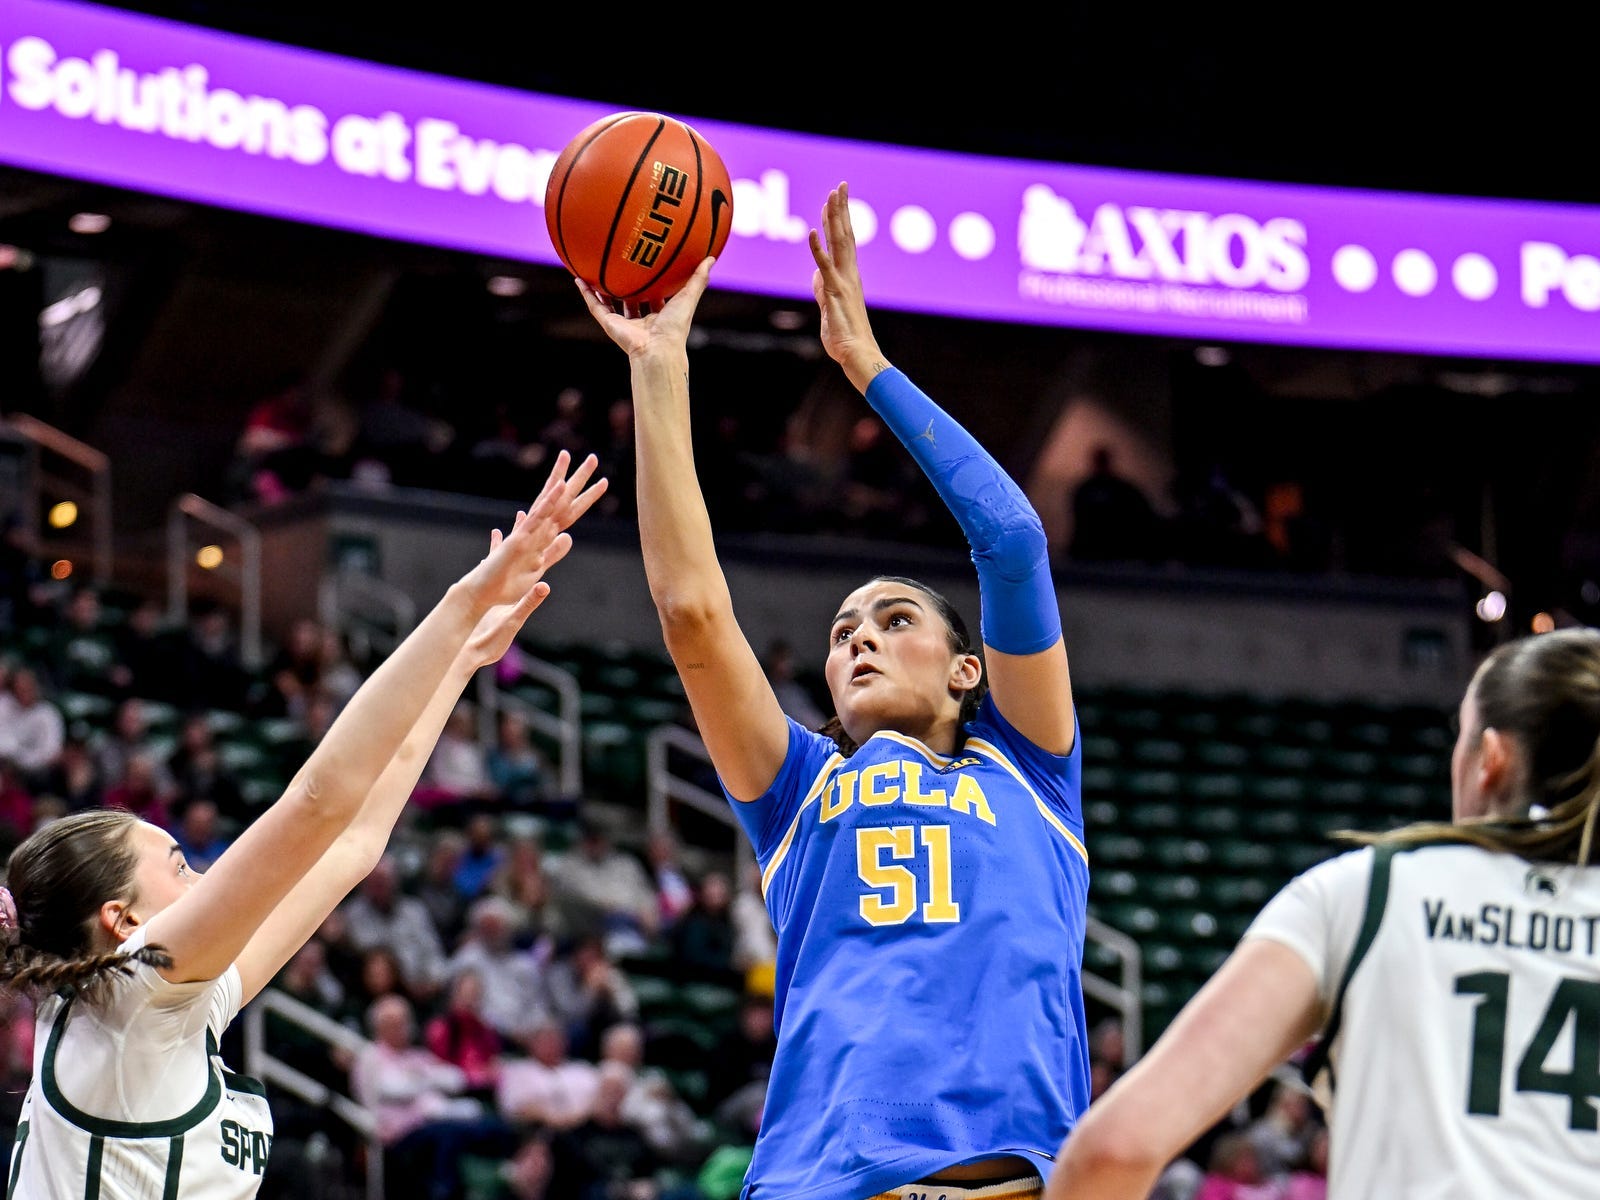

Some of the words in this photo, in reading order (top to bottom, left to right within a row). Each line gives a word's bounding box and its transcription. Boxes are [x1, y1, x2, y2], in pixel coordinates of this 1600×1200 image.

[6, 35, 330, 166] Solutions
[331, 111, 413, 183] at
[629, 164, 690, 269] ELITE
[1078, 201, 1311, 293] AXIOS
[818, 760, 997, 827] UCLA
[856, 825, 960, 927] 51
[1453, 970, 1600, 1133] 14
[220, 1118, 274, 1176] SPA
